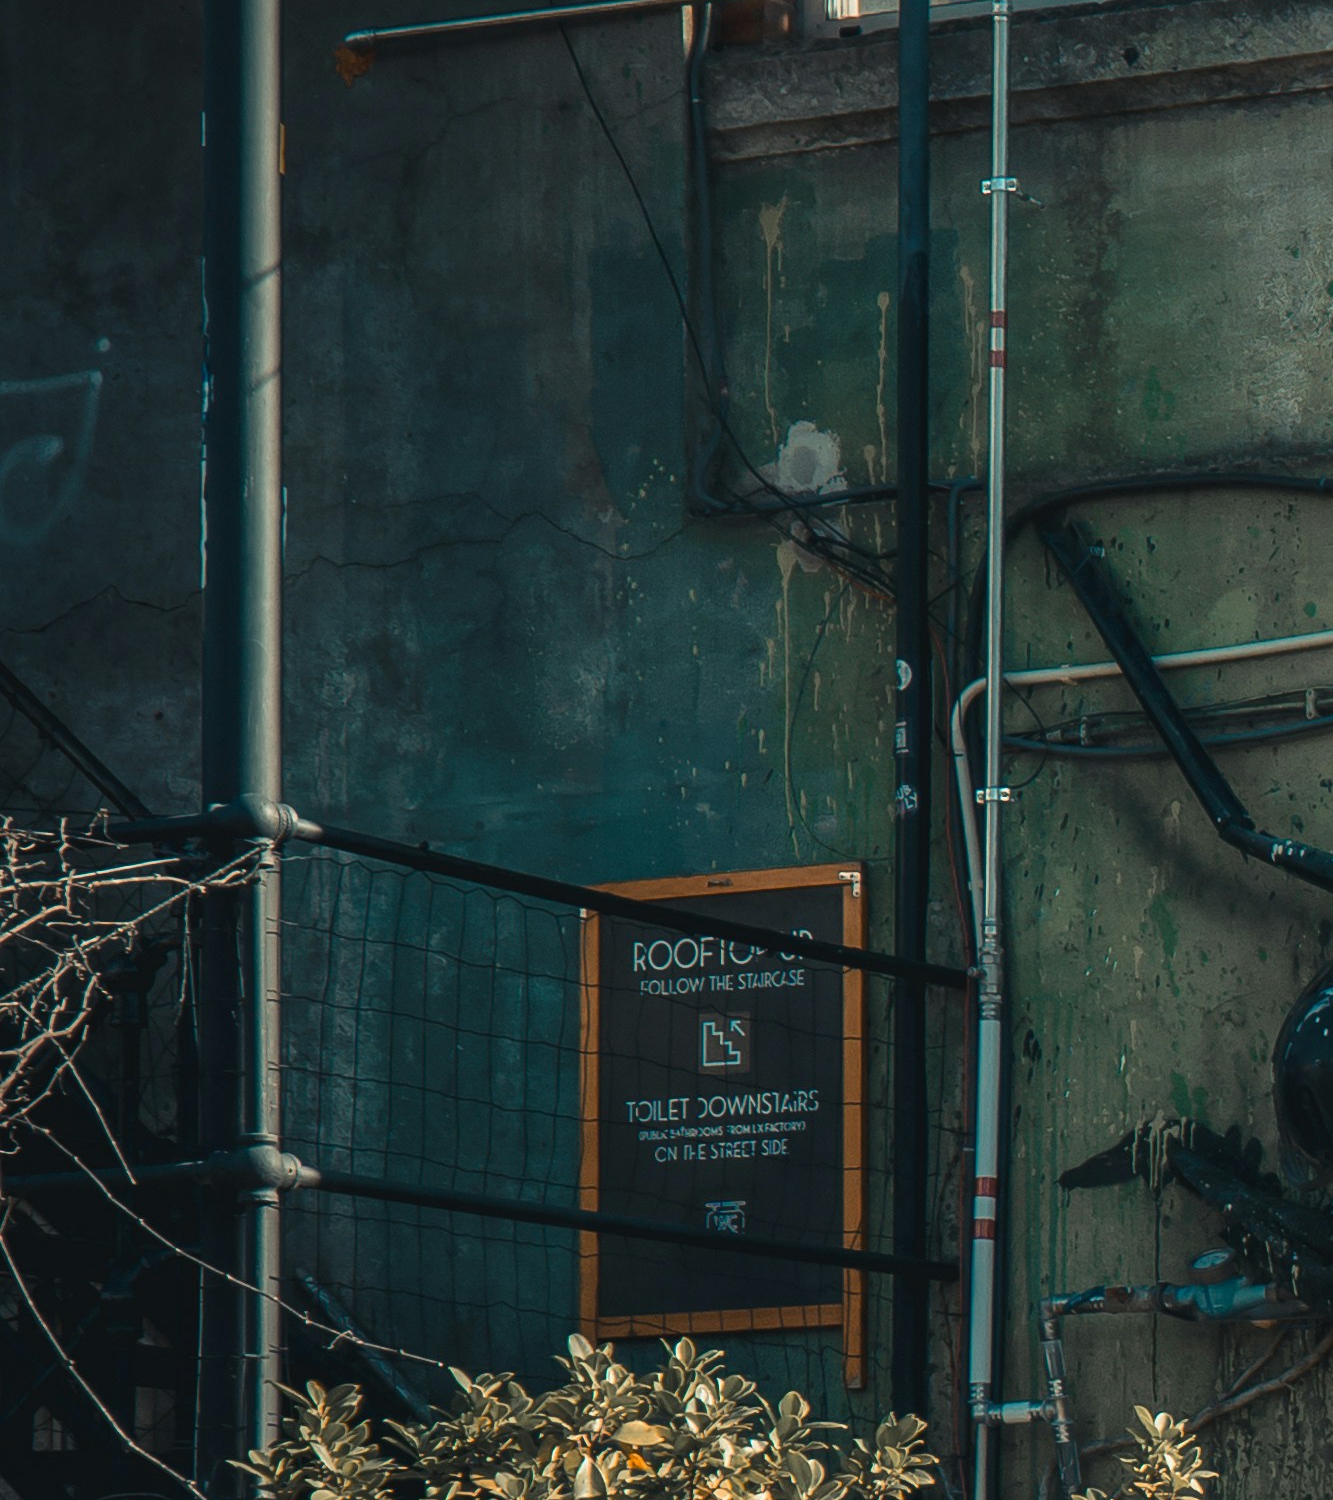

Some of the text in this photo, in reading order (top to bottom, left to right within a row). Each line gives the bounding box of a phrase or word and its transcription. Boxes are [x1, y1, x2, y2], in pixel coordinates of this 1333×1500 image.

[640, 969, 805, 996] FOLLOW THE STAIRCASE
[626, 1090, 820, 1122] TOILET DOWNSTAIRS
[654, 1138, 790, 1163] ON THE STREET SIDE
